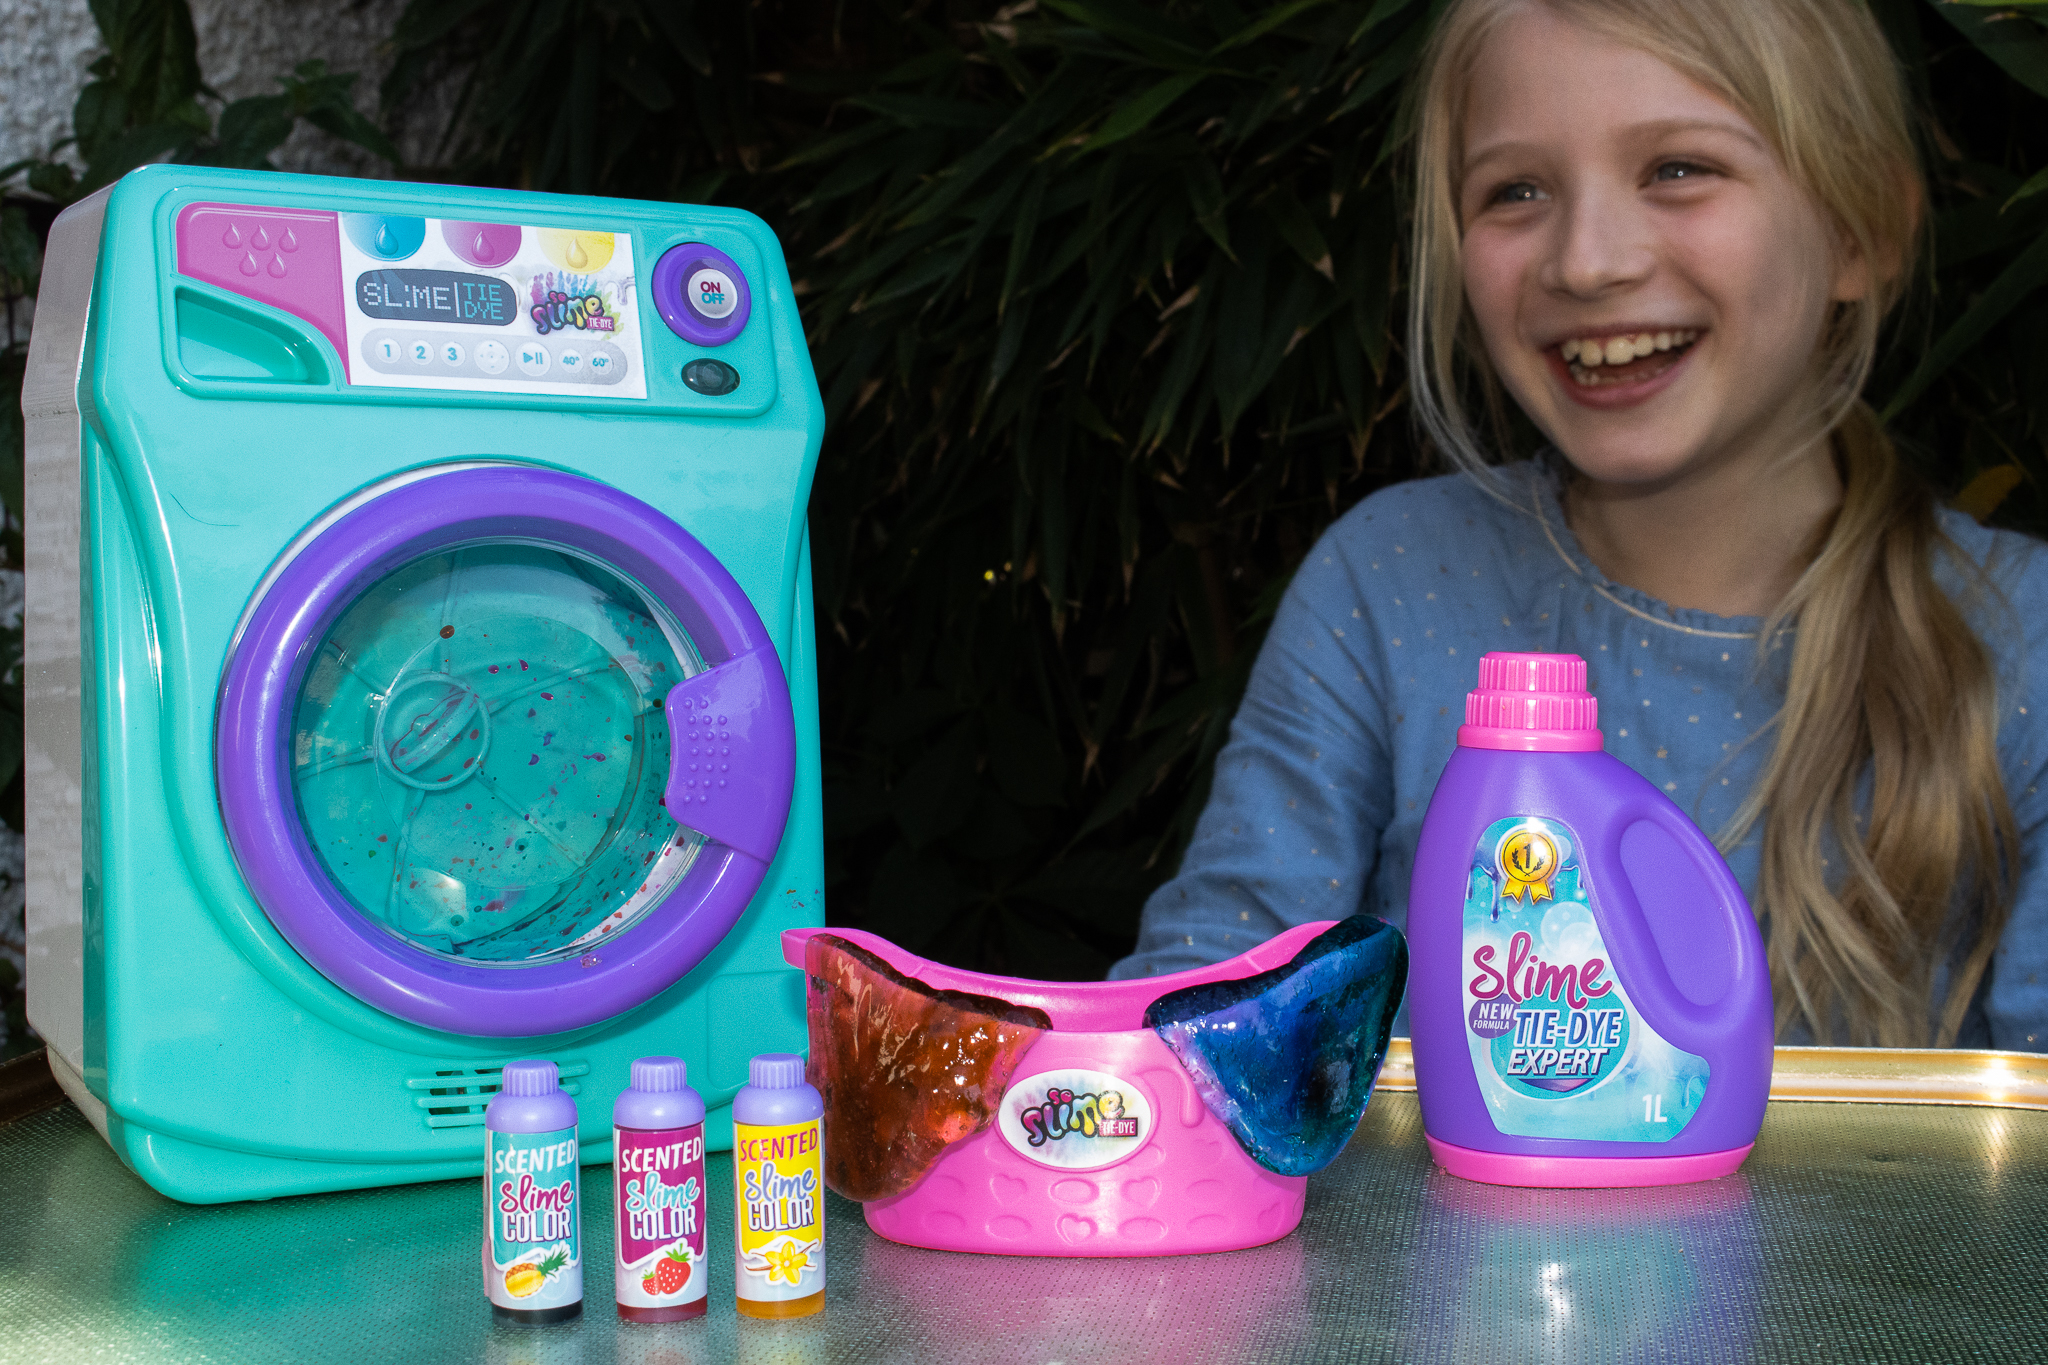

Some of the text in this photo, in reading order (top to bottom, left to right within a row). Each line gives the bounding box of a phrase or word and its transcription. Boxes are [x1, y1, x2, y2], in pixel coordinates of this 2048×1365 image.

[462, 282, 502, 301] TIE
[700, 281, 721, 293] ON
[701, 292, 725, 305] OFF
[464, 301, 504, 320] DYE
[385, 344, 391, 357] 1
[416, 346, 426, 359] 2
[447, 347, 458, 361] 3
[1523, 843, 1532, 869] 1
[1469, 931, 1613, 1010] Slime
[1473, 1019, 1510, 1030] FORMULA
[1479, 1002, 1514, 1020] NEW
[1514, 1010, 1623, 1046] TIE-DYE
[1507, 1048, 1610, 1075] EXPERT
[1641, 1094, 1668, 1123] 1L
[495, 1138, 576, 1175] SCENTED
[621, 1136, 702, 1173] SCENTED
[740, 1127, 818, 1163] SCENTED
[500, 1174, 574, 1213] Slime
[625, 1171, 700, 1213] Slime
[744, 1161, 817, 1203] Slime
[503, 1208, 573, 1243] COLOR
[629, 1205, 697, 1240] COLOR
[748, 1195, 815, 1231] COLOR
